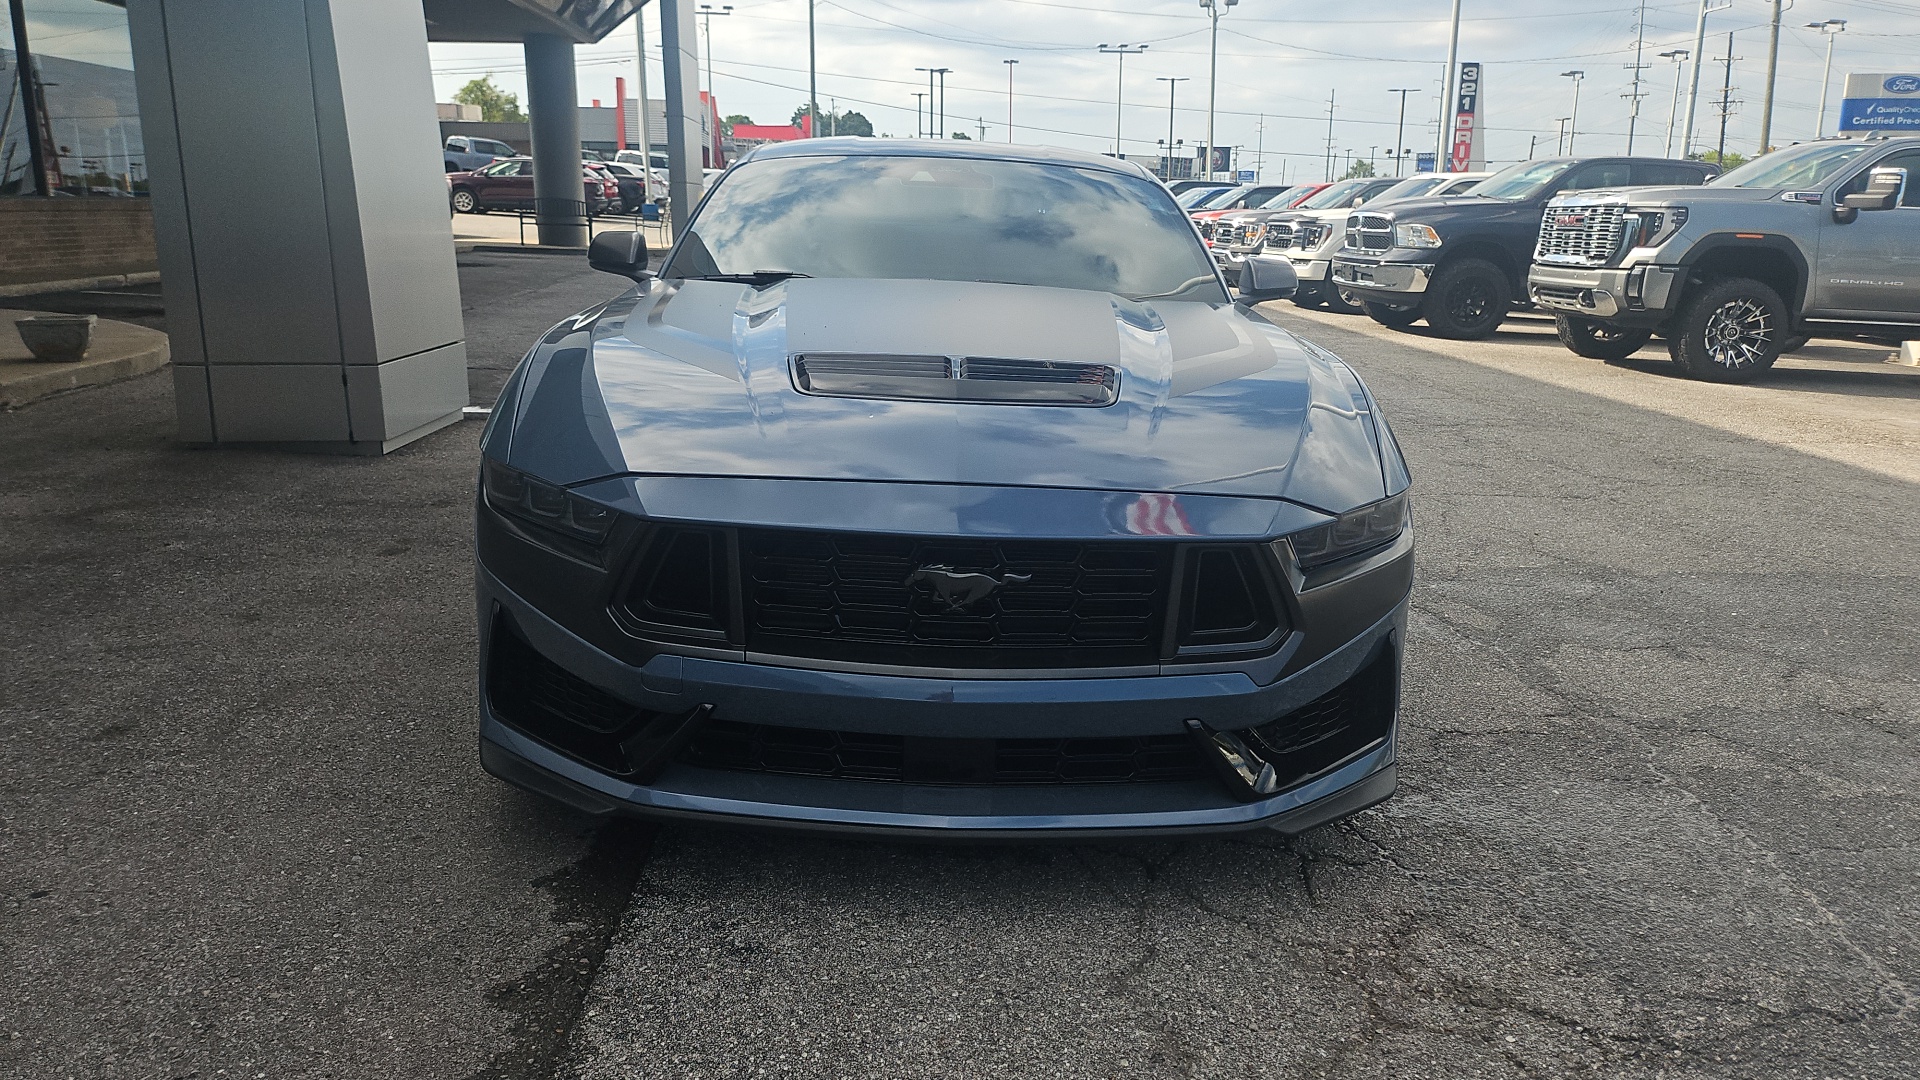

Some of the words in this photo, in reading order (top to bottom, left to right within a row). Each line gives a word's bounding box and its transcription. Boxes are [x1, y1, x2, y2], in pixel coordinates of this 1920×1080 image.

[1460, 67, 1478, 110] 321
[1892, 79, 1918, 90] Ford
[1852, 116, 1895, 125] Certified
[1453, 116, 1474, 172] DRIV
[1554, 215, 1585, 226] GMC
